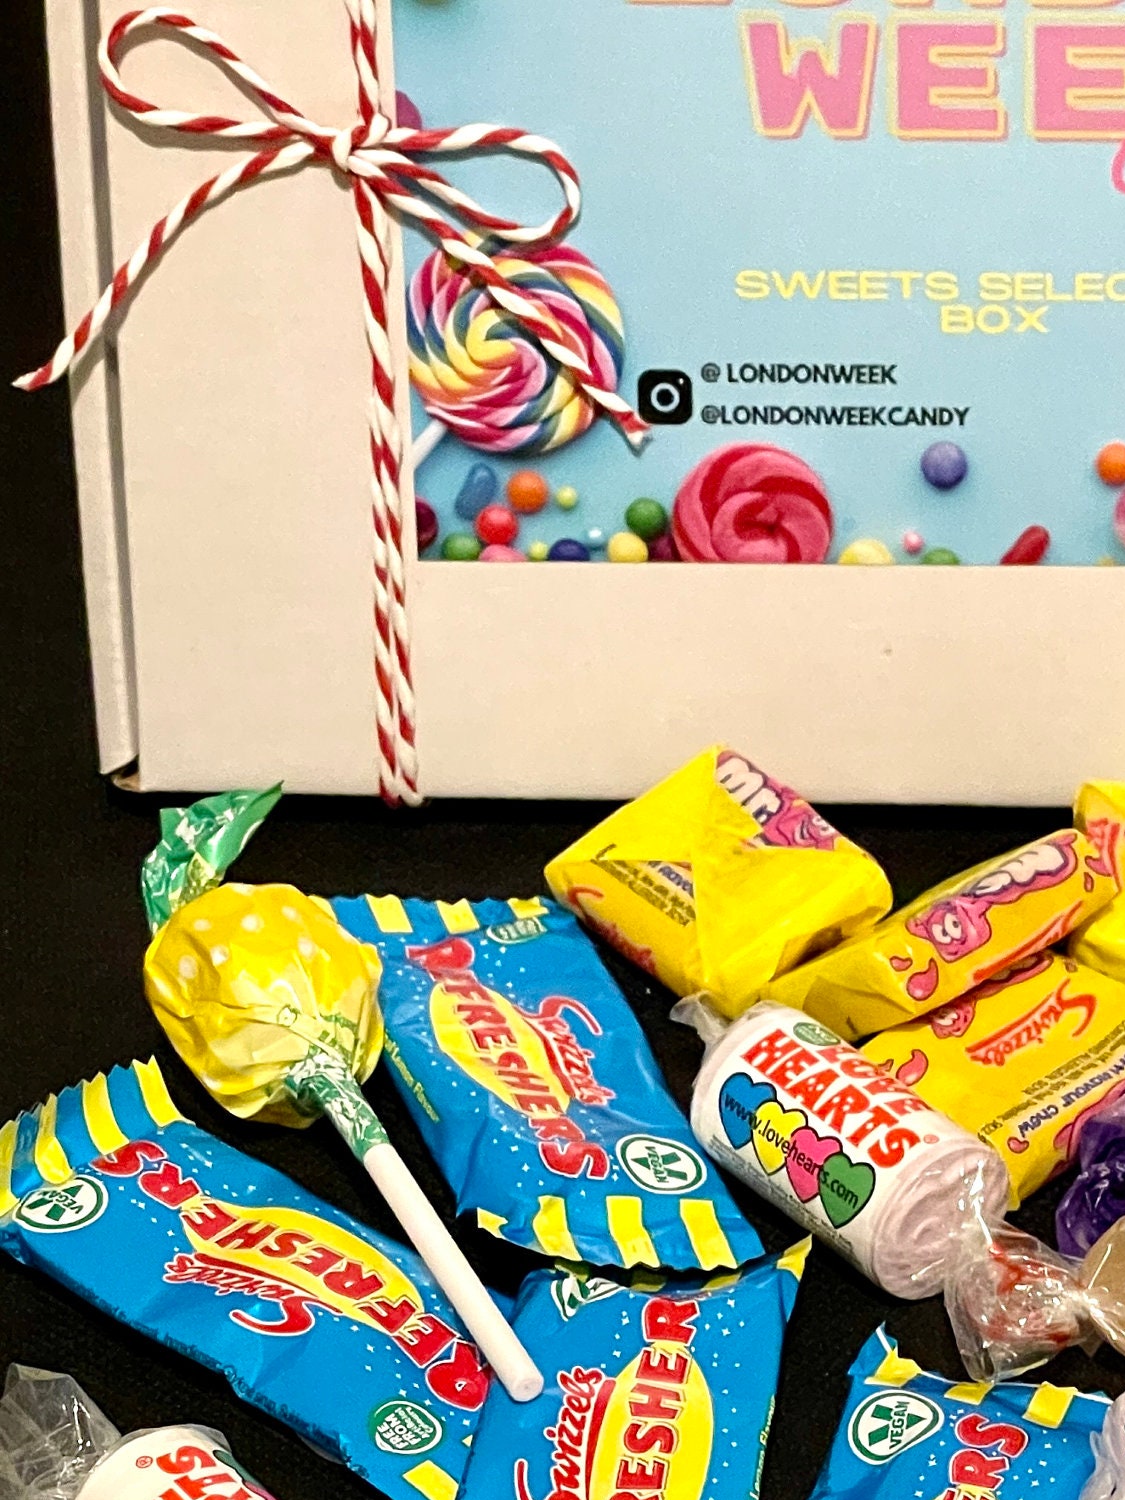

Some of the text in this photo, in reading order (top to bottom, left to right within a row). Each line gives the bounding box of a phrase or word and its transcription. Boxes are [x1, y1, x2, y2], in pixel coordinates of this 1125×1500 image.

[734, 268, 960, 301] SWEETS
[939, 303, 1049, 335] BOX
[726, 362, 898, 385] LONDONWEEK
[701, 405, 971, 427] @LONDONWEEKCANDY
[965, 978, 1097, 1068] Swizzels
[740, 1028, 922, 1169] HEARTS
[89, 1139, 493, 1413] REFRESHERS
[376, 1423, 409, 1450] FREE
[384, 1411, 421, 1444] FROM
[888, 1400, 910, 1450] VEGAN
